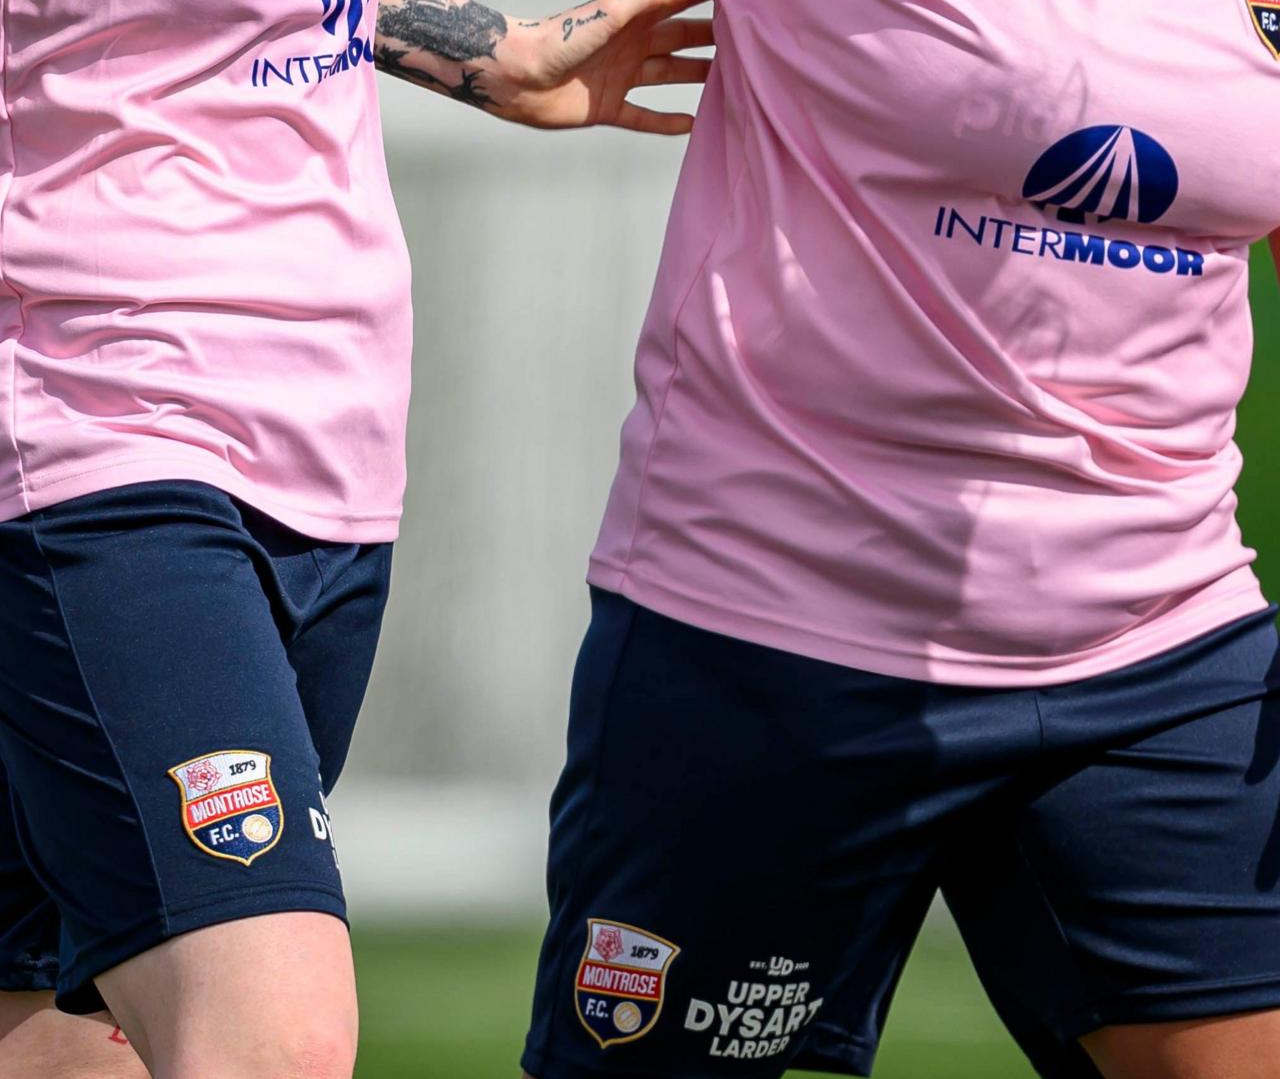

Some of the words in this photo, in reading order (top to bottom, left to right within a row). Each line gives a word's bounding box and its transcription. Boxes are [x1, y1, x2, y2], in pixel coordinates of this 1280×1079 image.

[1261, 11, 1279, 32] F.C.
[934, 206, 1205, 276] INTERMOOR
[228, 760, 256, 776] 1879
[190, 783, 272, 823] MONTROSE
[209, 824, 240, 845] F.C.
[630, 945, 659, 960] 1879
[768, 956, 794, 976] UD
[582, 965, 658, 995] MONTROSE
[727, 980, 810, 1007] UPPER
[585, 998, 609, 1018] F.C.
[684, 997, 824, 1038] DYSART
[709, 1036, 790, 1059] LARDER
